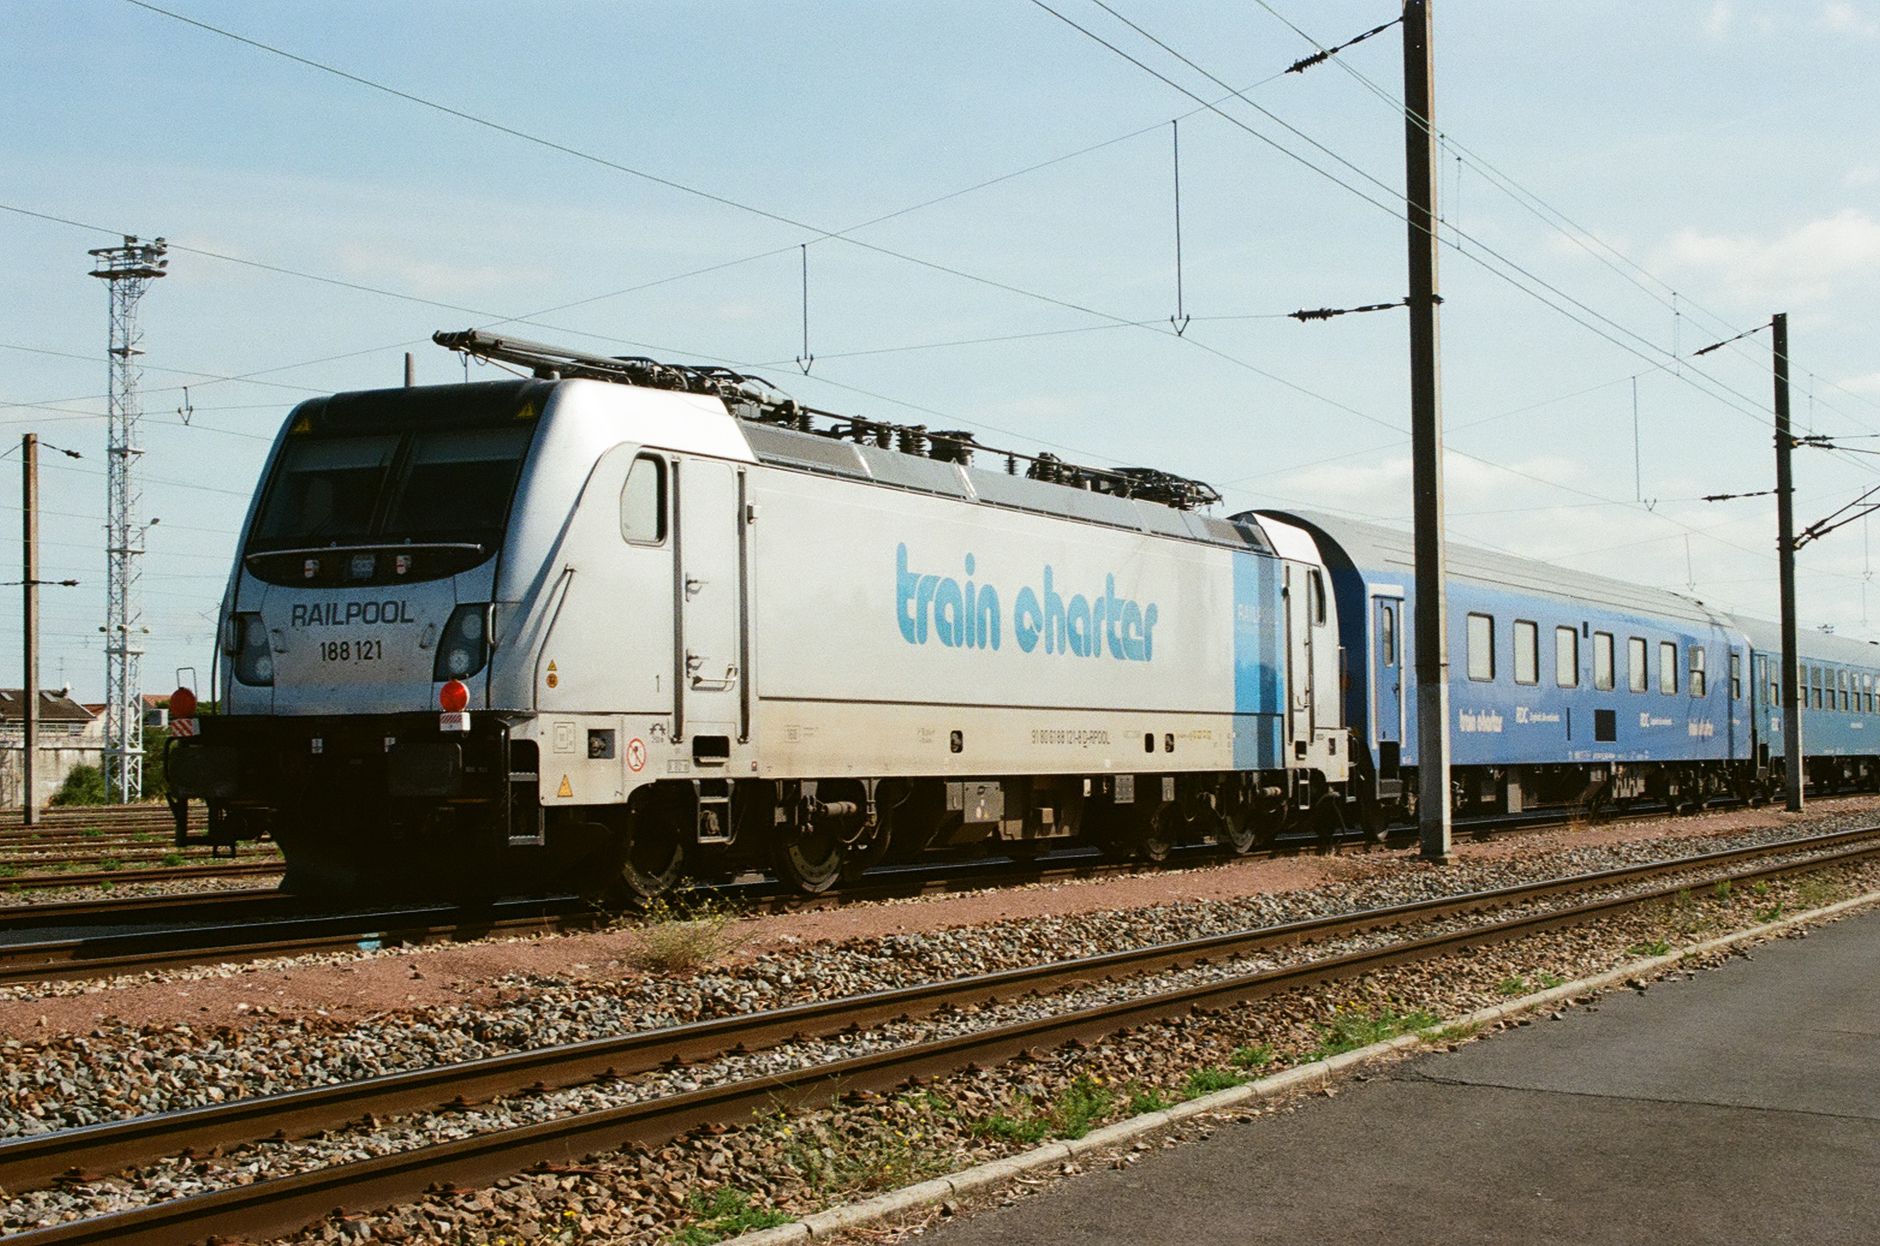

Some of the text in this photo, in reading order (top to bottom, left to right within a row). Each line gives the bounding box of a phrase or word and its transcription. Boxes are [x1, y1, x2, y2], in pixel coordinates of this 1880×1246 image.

[291, 600, 414, 626] RAILPOOL
[896, 542, 1158, 662] train charter
[320, 640, 382, 661] 188 121
